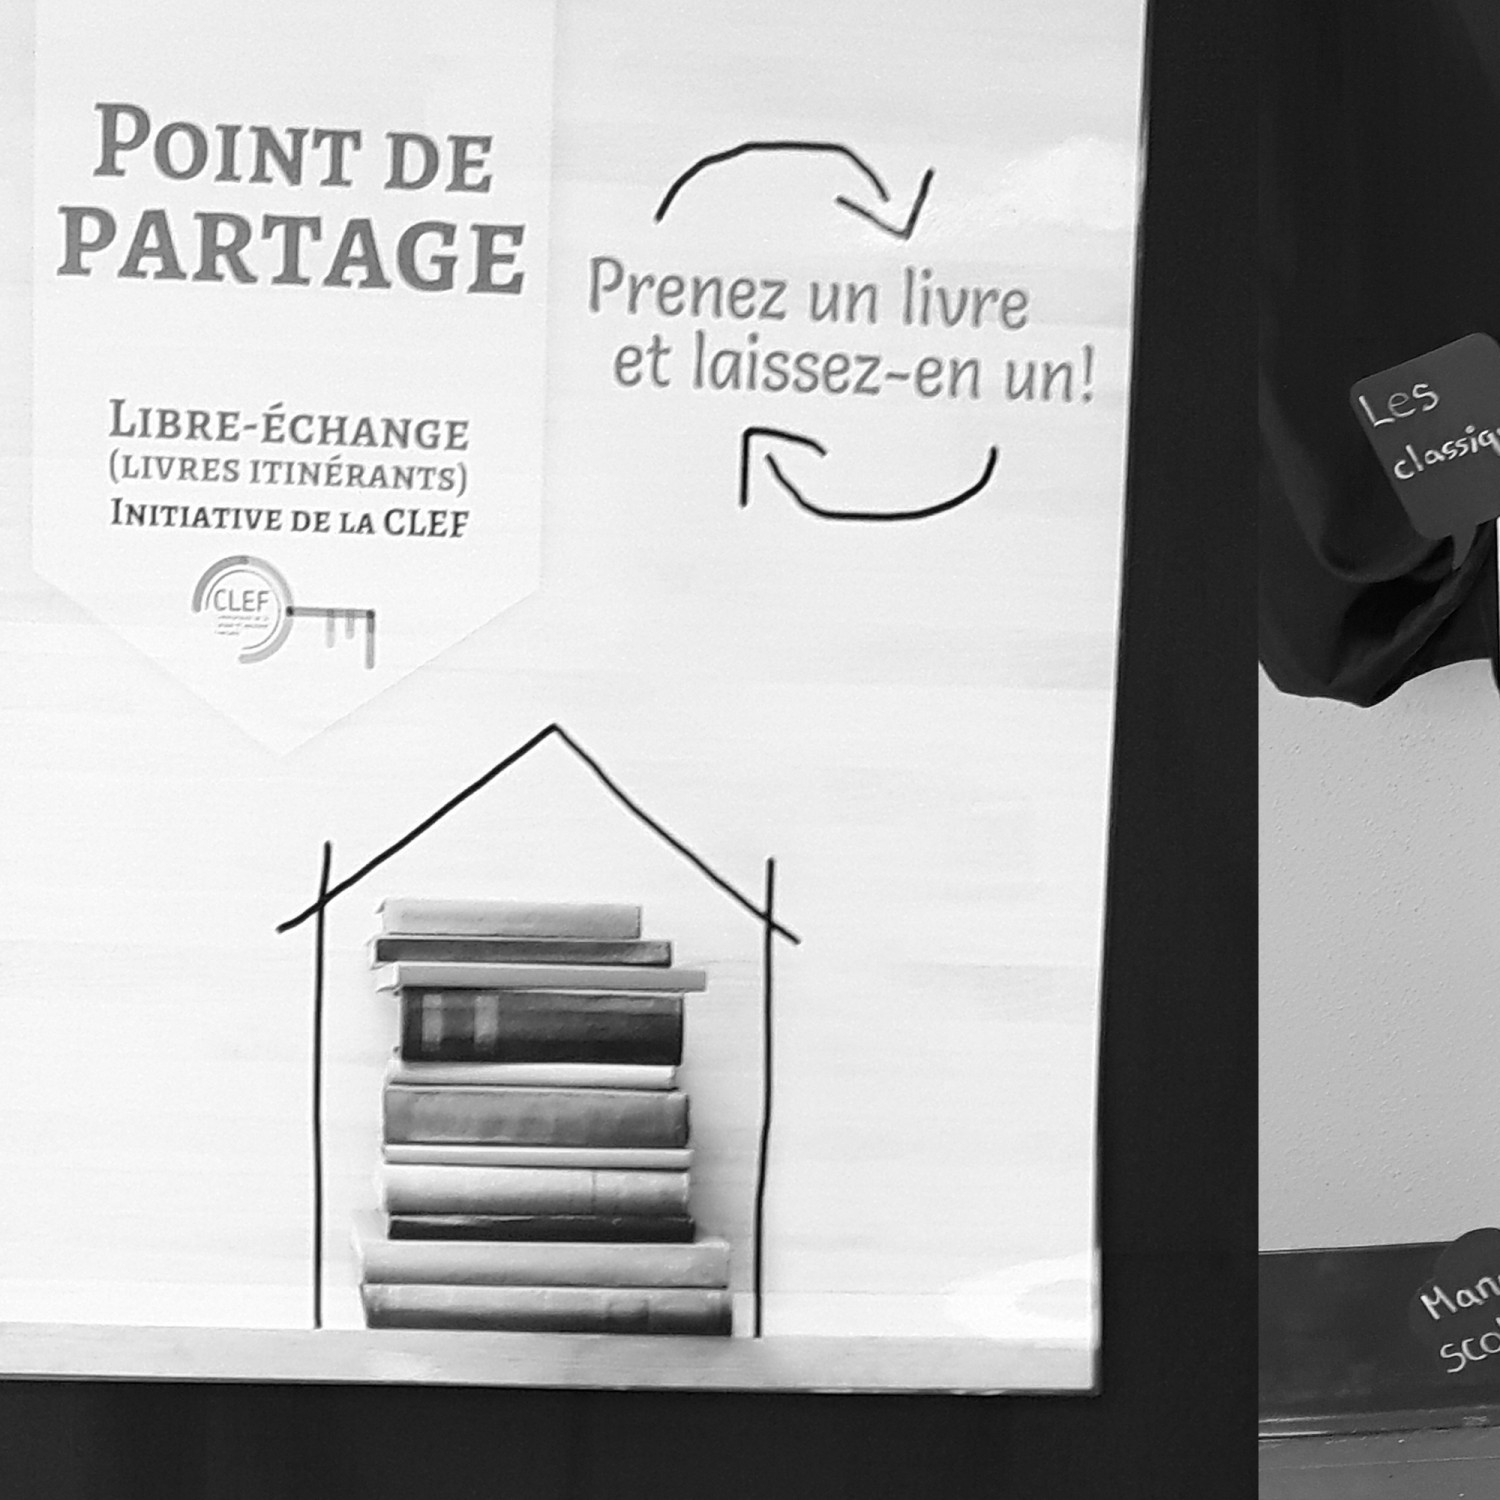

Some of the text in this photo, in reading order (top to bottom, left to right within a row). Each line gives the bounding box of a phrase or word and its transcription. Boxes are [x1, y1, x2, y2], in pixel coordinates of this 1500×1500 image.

[57, 206, 526, 295] PARTAGE
[588, 255, 1030, 330] Prenez un livre
[614, 329, 1095, 402] et laissez-en un!
[109, 399, 469, 451] LIBRE-ÉCHANGE
[1358, 381, 1440, 427] Les
[109, 449, 468, 497] (LIVRES ITINÉRANTS)
[110, 498, 470, 538] INITIATIVE DE LA CLEF
[213, 588, 270, 612] CLEF
